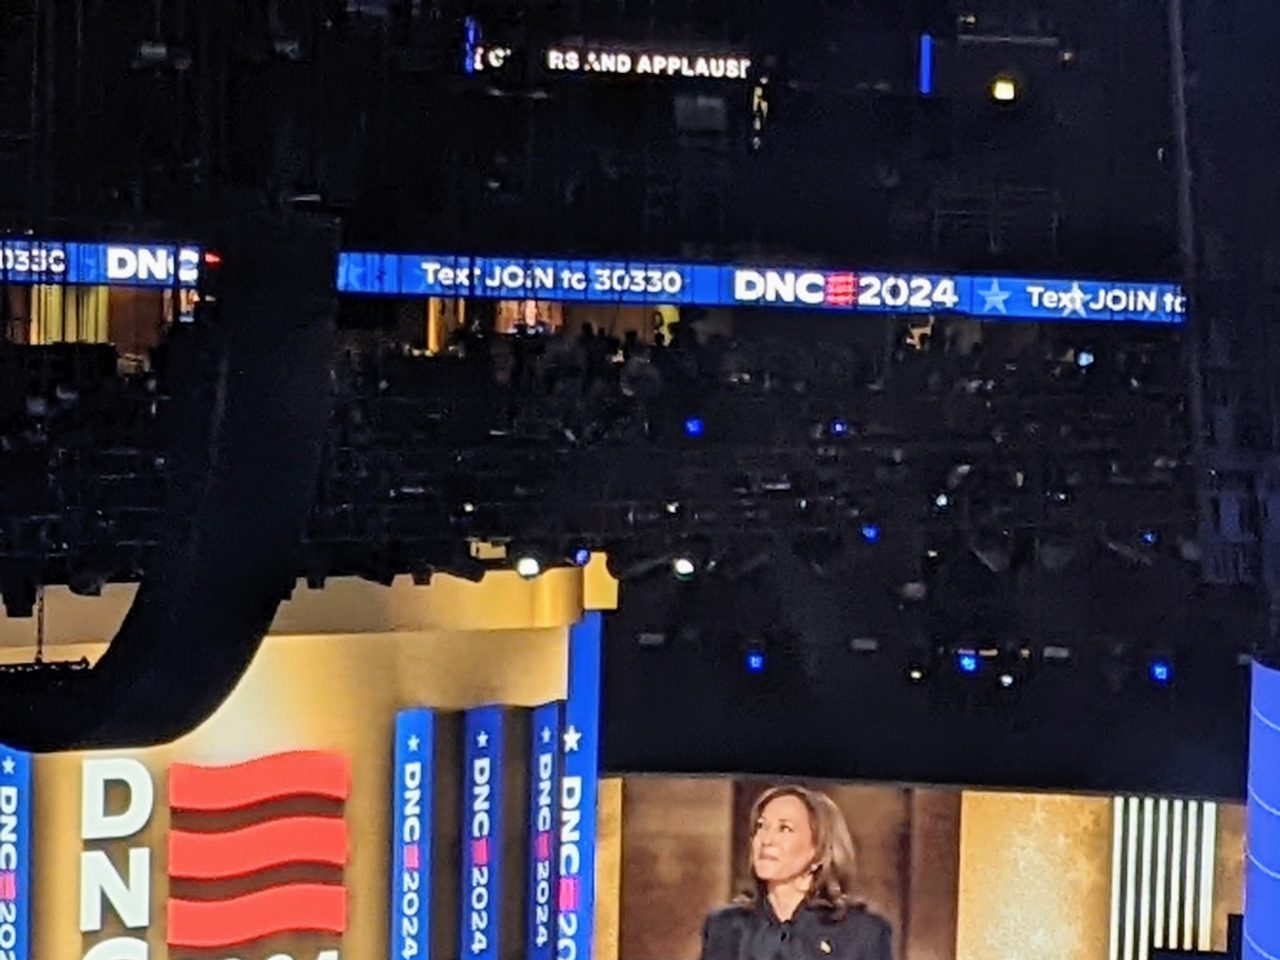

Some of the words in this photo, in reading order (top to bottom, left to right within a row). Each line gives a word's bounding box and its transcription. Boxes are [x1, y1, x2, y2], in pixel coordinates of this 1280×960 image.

[594, 269, 683, 293] 30330
[734, 268, 825, 304] DNC
[857, 276, 959, 307] 2024
[1026, 286, 1084, 310] Text
[1089, 288, 1157, 312] JOIN
[404, 762, 422, 844] DNC
[472, 757, 490, 838] DNC
[536, 753, 552, 832] DNC
[558, 776, 582, 881] DNC
[401, 872, 420, 960] 2024
[471, 867, 489, 954] 2024
[535, 861, 551, 947] 2024
